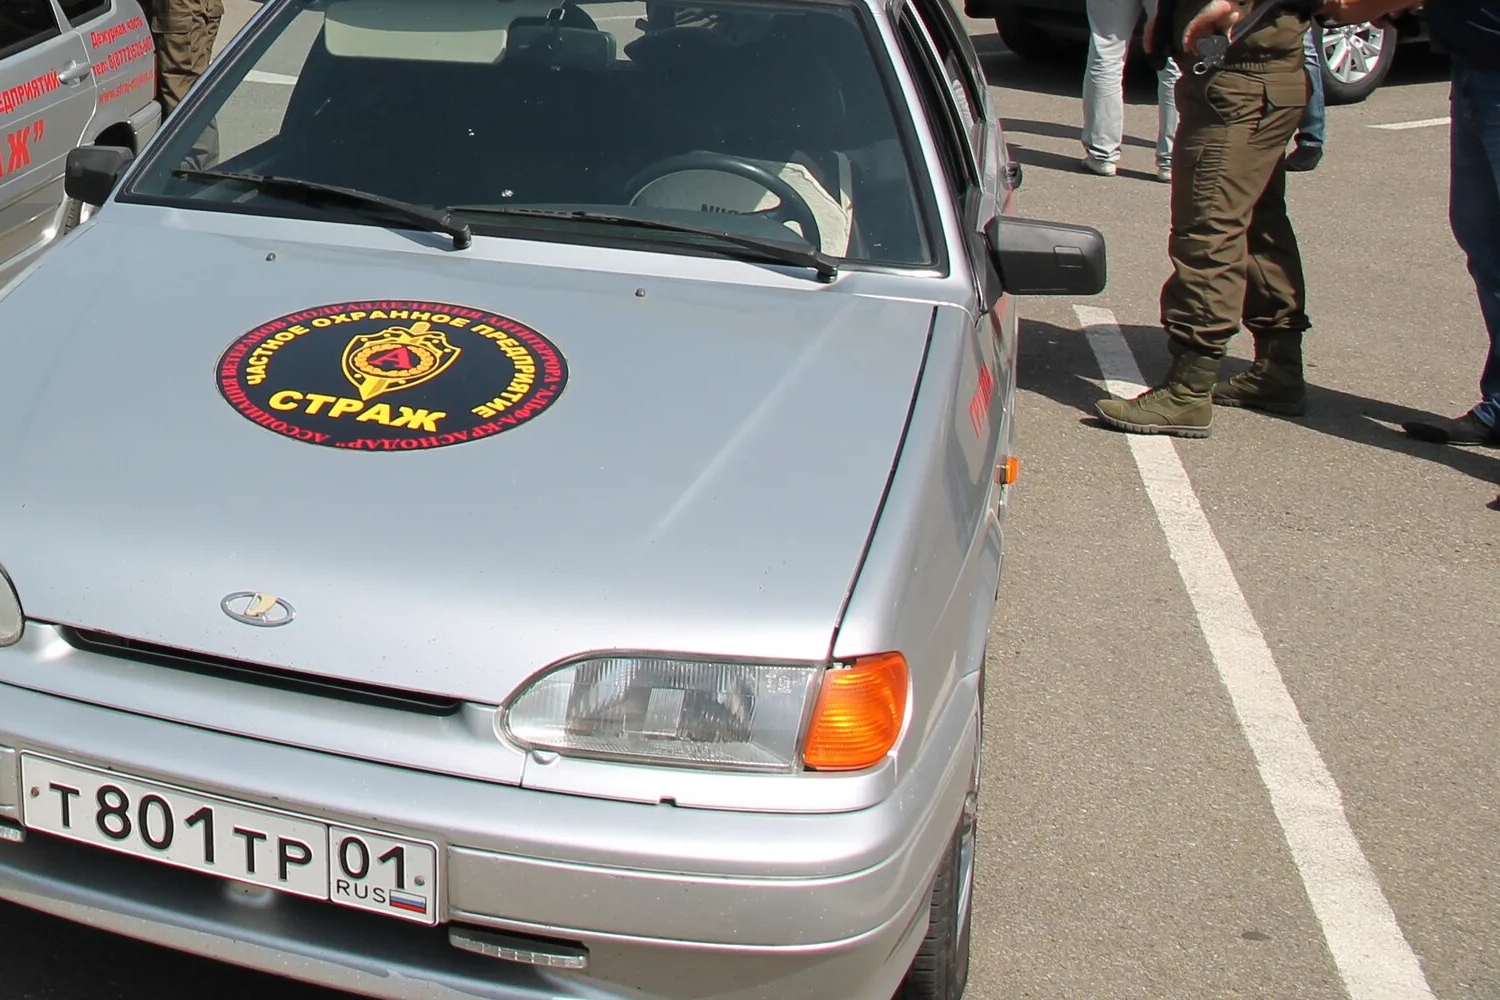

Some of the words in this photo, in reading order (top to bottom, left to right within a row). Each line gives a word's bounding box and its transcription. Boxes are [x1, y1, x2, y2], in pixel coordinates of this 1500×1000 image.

[246, 323, 311, 386] ЧАСТНОЕ
[311, 309, 472, 328] ОХРАННОЕ
[470, 323, 537, 420] ПРЕДПРИЯТИЕ
[267, 389, 447, 432] СТРАЖ
[49, 780, 314, 882] Т801ТР
[338, 834, 407, 890] 01
[335, 878, 387, 905] RUS
